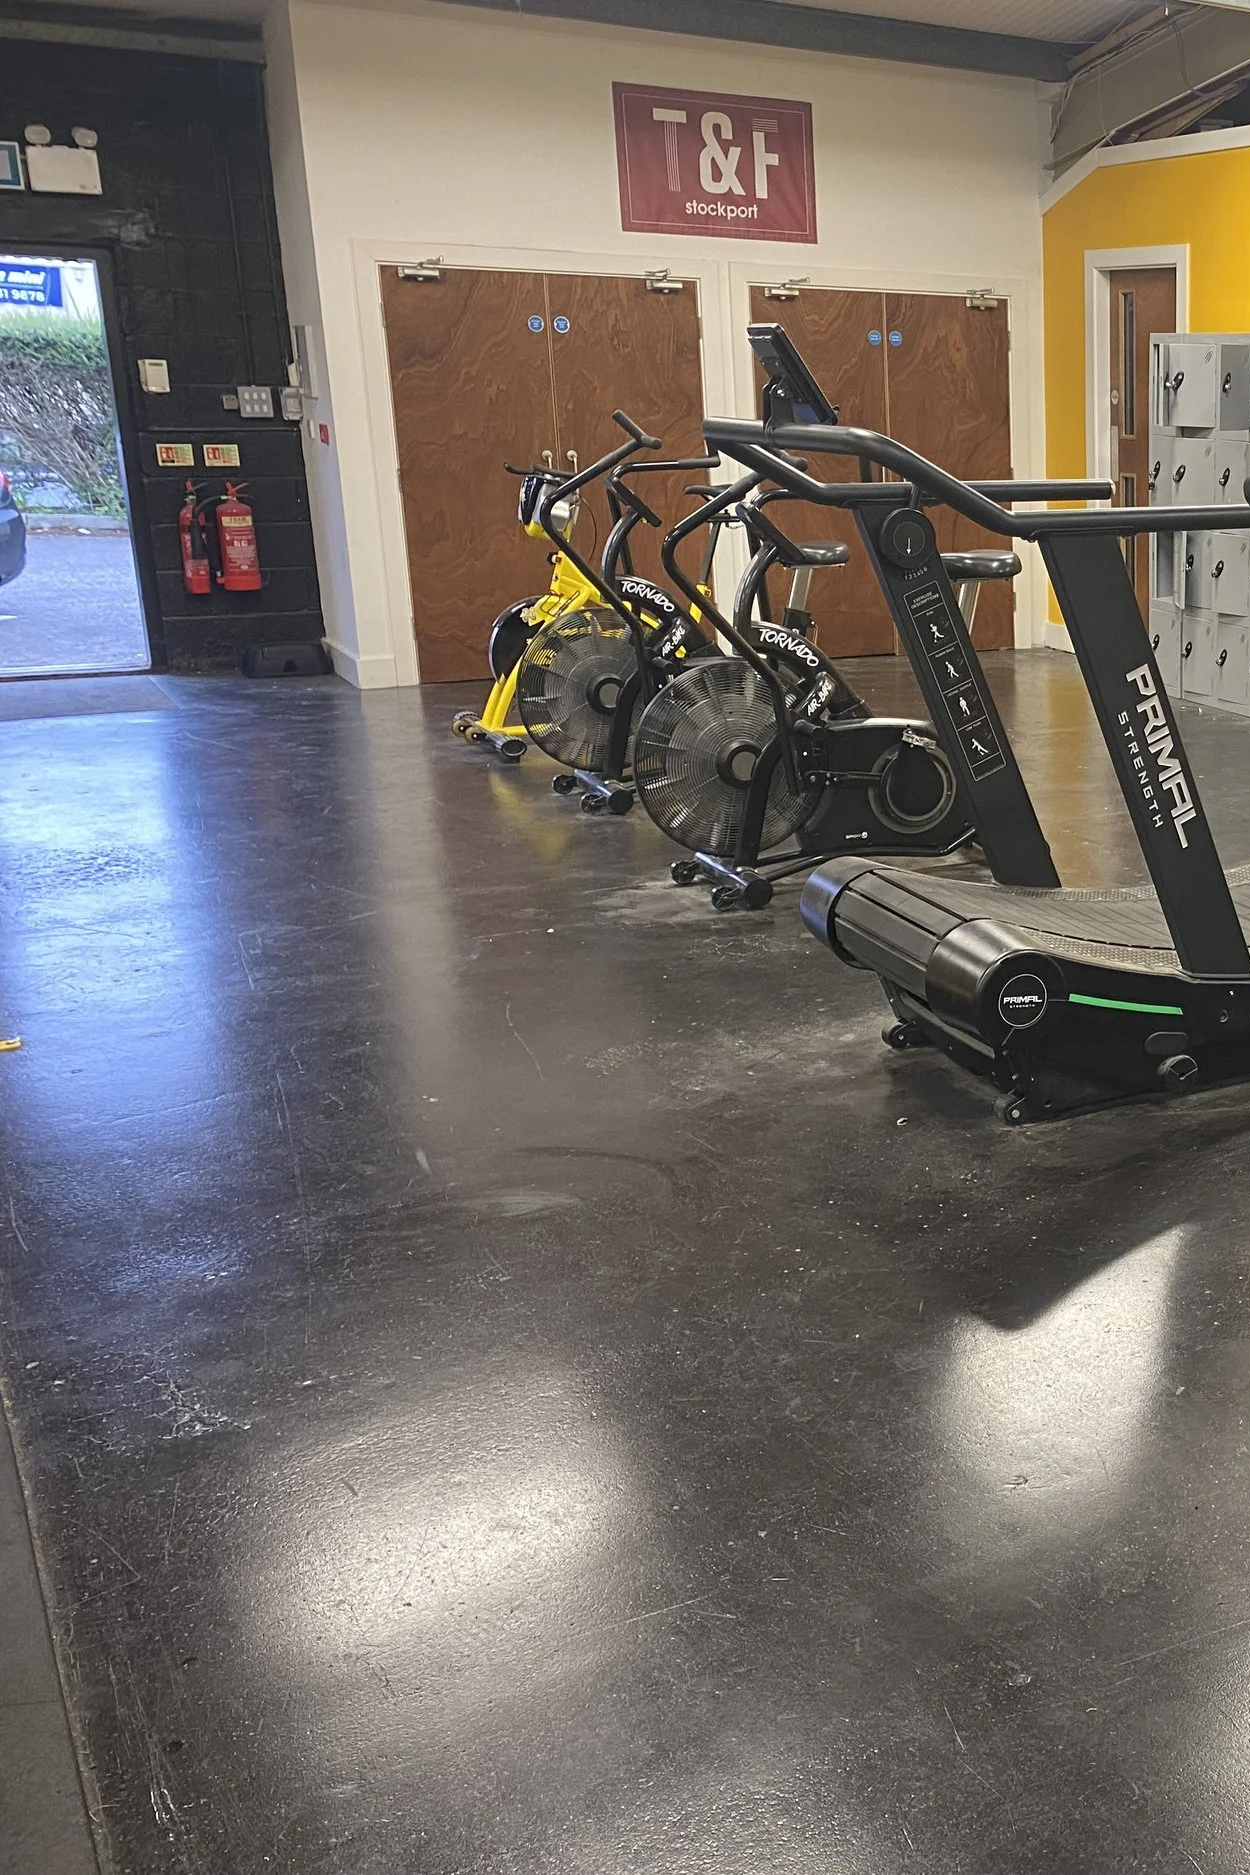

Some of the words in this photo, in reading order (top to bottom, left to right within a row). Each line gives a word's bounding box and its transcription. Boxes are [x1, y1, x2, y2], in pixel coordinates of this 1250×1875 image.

[685, 200, 758, 220] stockport
[621, 580, 675, 613] TORNADO
[661, 625, 686, 657] AIR-BIKE
[759, 628, 819, 667] TORNADO
[807, 679, 834, 716] AIR-BIKE
[1117, 711, 1164, 828] STRENGTH
[1125, 663, 1197, 849] PRIMAL
[1003, 995, 1043, 1004] PRIMAL
